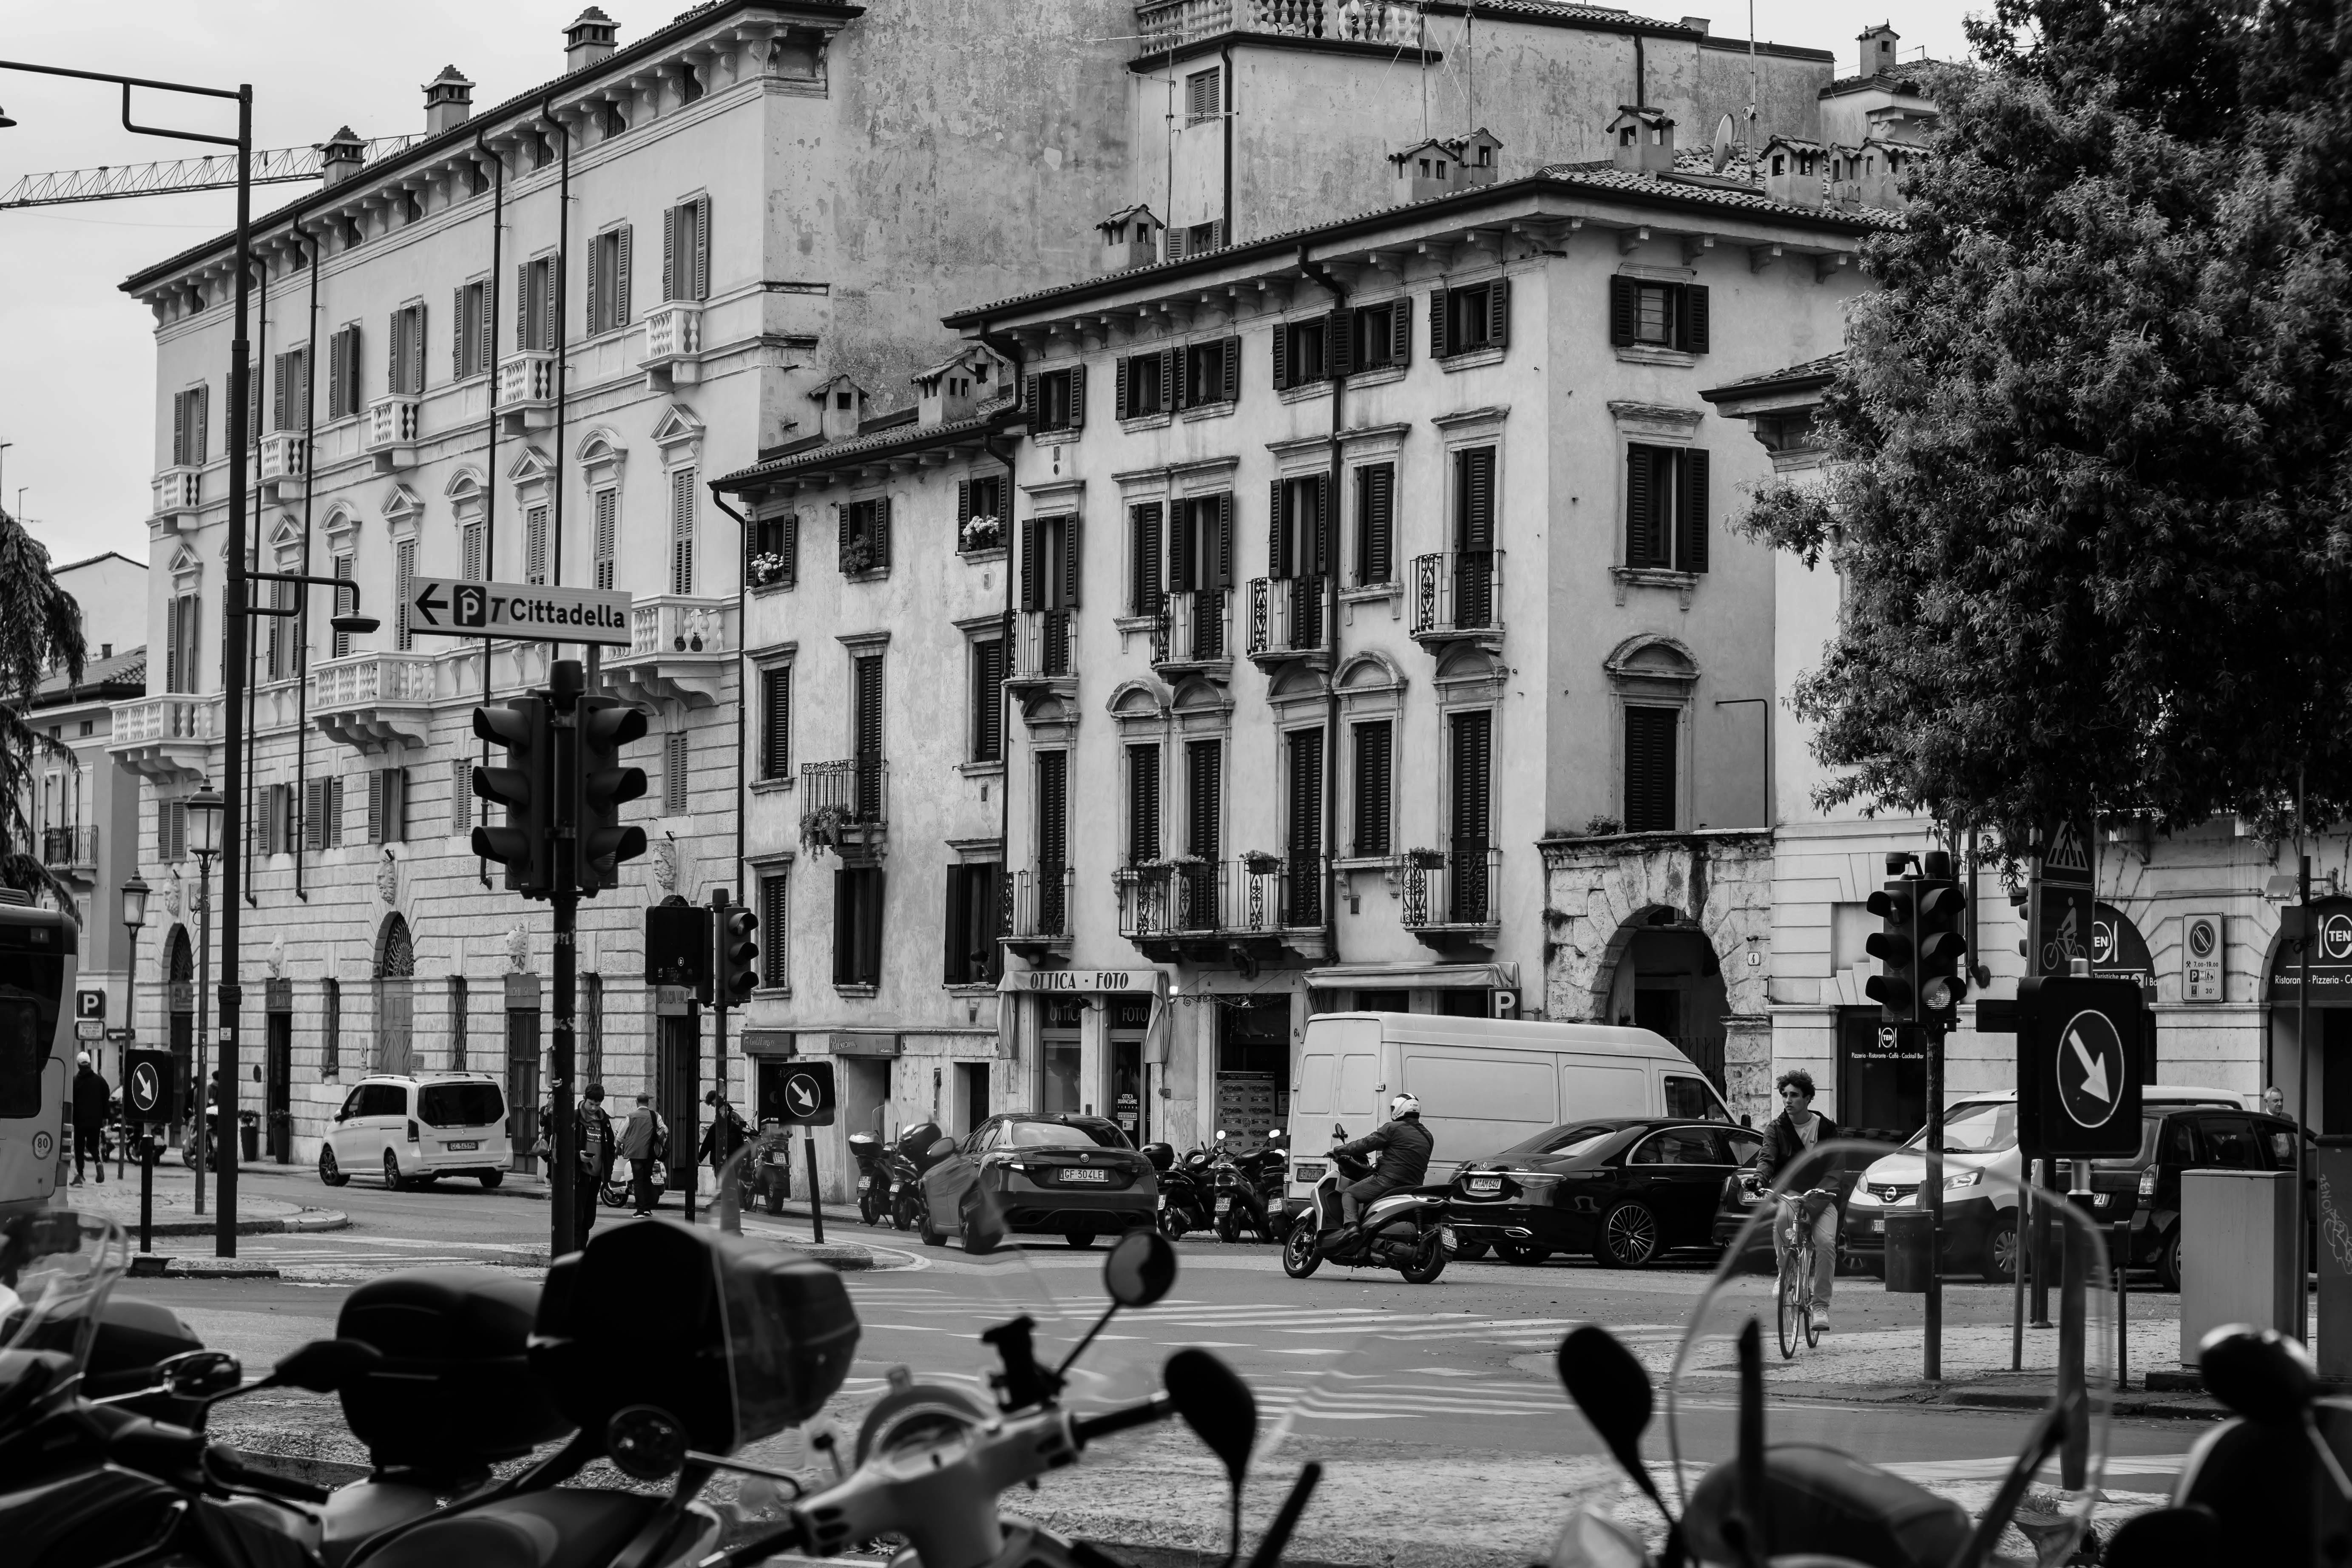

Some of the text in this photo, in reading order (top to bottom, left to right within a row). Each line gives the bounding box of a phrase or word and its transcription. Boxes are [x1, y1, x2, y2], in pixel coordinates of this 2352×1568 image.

[463, 598, 478, 624] P
[510, 598, 625, 628] Cittadella
[2329, 930, 2351, 942] TEN
[2094, 937, 2108, 947] EN
[1751, 954, 1755, 963] 4
[1031, 972, 1128, 989] OTTICA FOTO
[2192, 971, 2197, 981] P
[2275, 975, 2301, 984] Ristoran
[2313, 975, 2339, 984] Pizzeria
[84, 994, 98, 1014] P
[1496, 991, 1515, 1017] P
[1050, 1007, 1148, 1021] OTTICA FOTO
[995, 1043, 999, 1051] 8
[38, 1138, 48, 1148] 80
